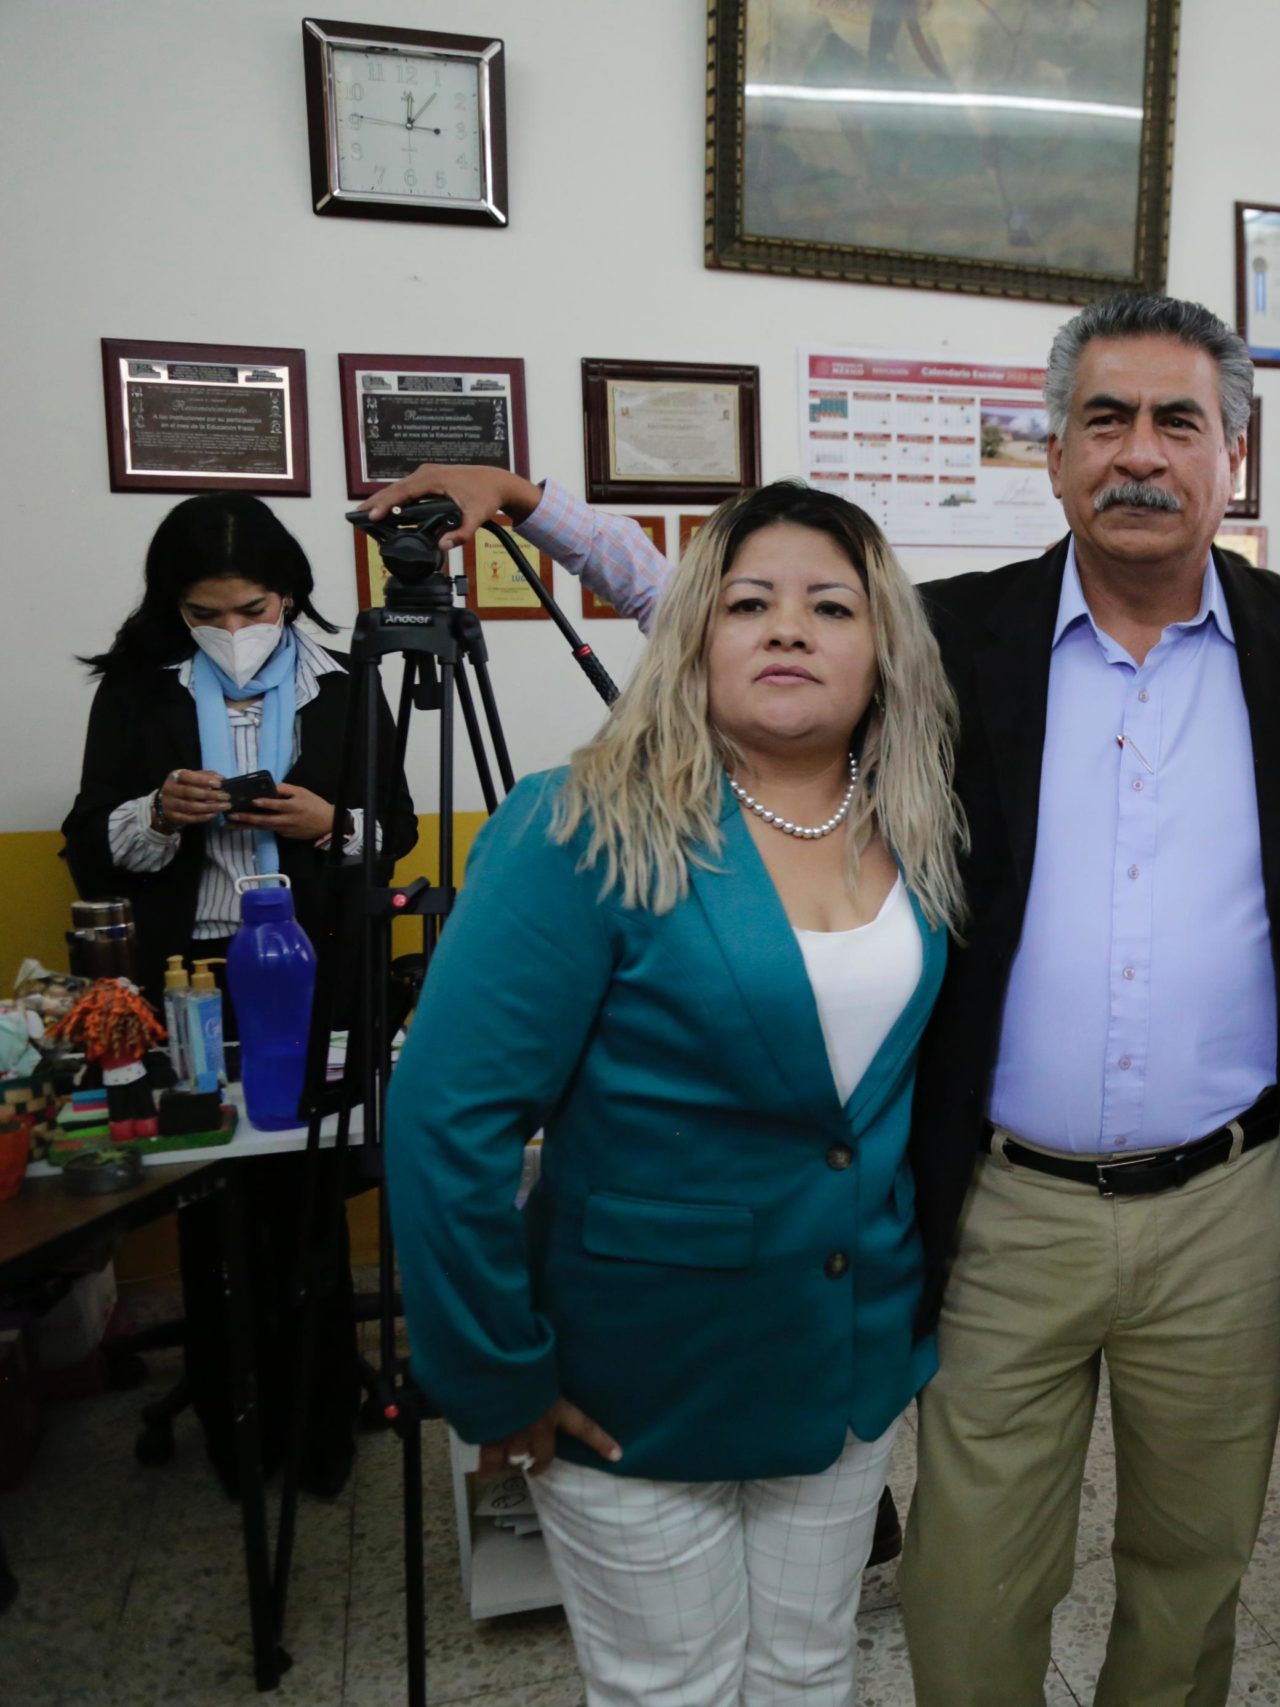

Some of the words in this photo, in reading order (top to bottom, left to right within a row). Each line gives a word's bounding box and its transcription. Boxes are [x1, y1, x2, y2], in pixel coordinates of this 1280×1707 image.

[367, 61, 385, 82] 11
[395, 63, 418, 85] 12
[432, 69, 442, 87] 1
[345, 82, 365, 102] 10
[454, 91, 467, 112] 2
[455, 121, 467, 141] 3
[455, 151, 468, 171] 4
[374, 164, 386, 185] 7
[403, 167, 417, 187] 6
[435, 170, 447, 189] 5
[920, 366, 971, 379] Calendario
[972, 369, 1005, 381] Escolar
[385, 614, 432, 624] Andoer
